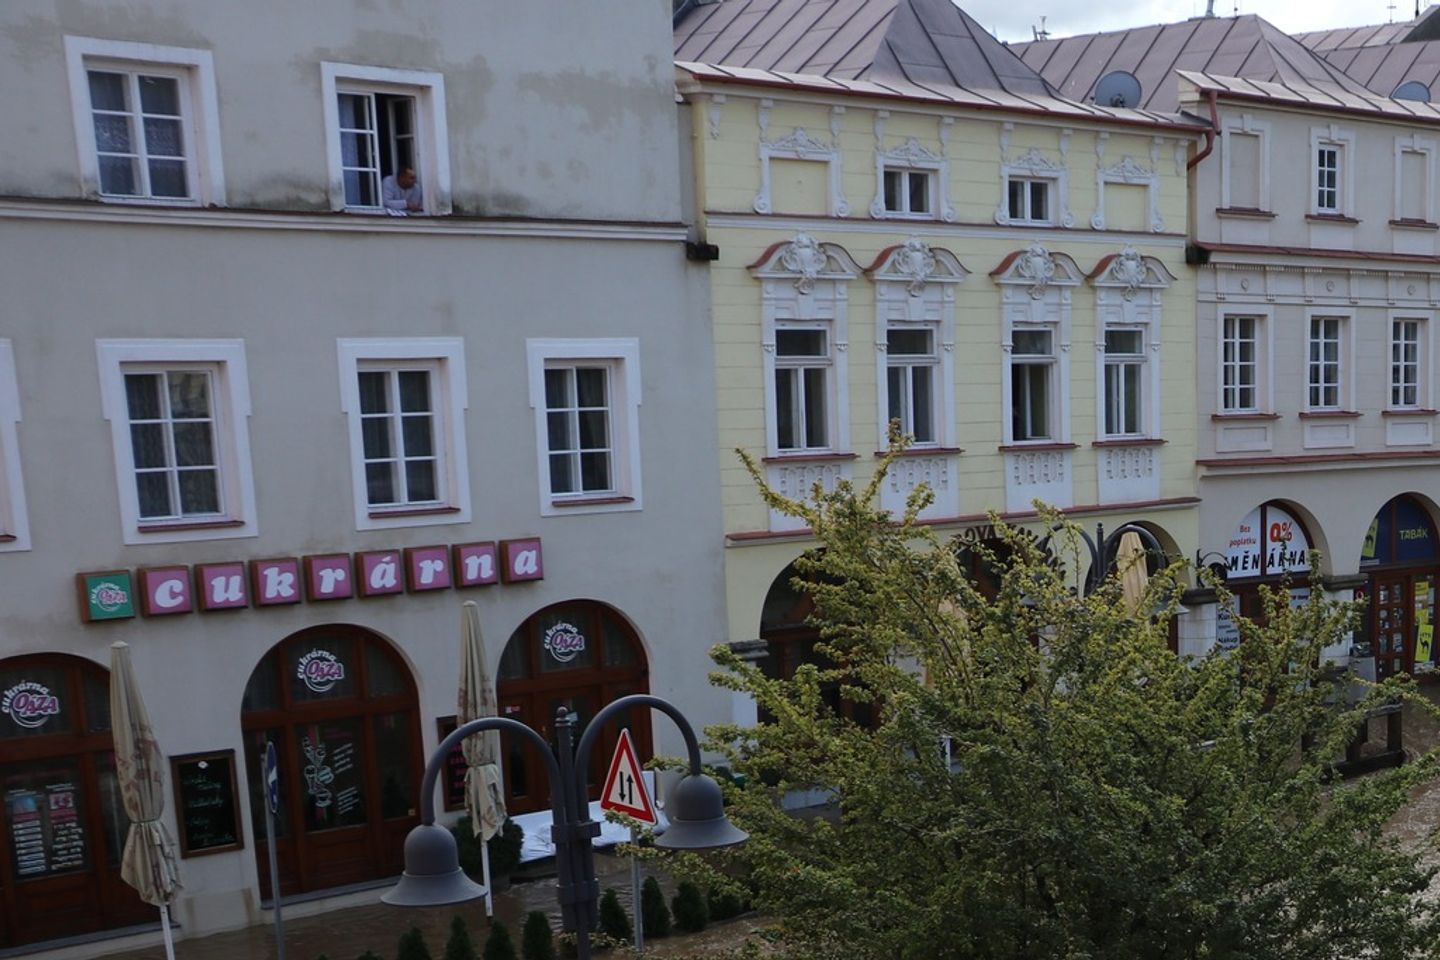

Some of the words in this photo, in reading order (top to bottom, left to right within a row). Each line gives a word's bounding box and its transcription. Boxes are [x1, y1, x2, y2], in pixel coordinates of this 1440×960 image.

[1269, 520, 1293, 543] 0%
[1399, 526, 1429, 540] TABÁK
[1224, 547, 1306, 572] MĚNÁRNA
[154, 548, 538, 608] cukrárna
[297, 648, 337, 679] cukrárna
[2, 680, 49, 713] cukrárna
[13, 692, 60, 717] OÁZA
